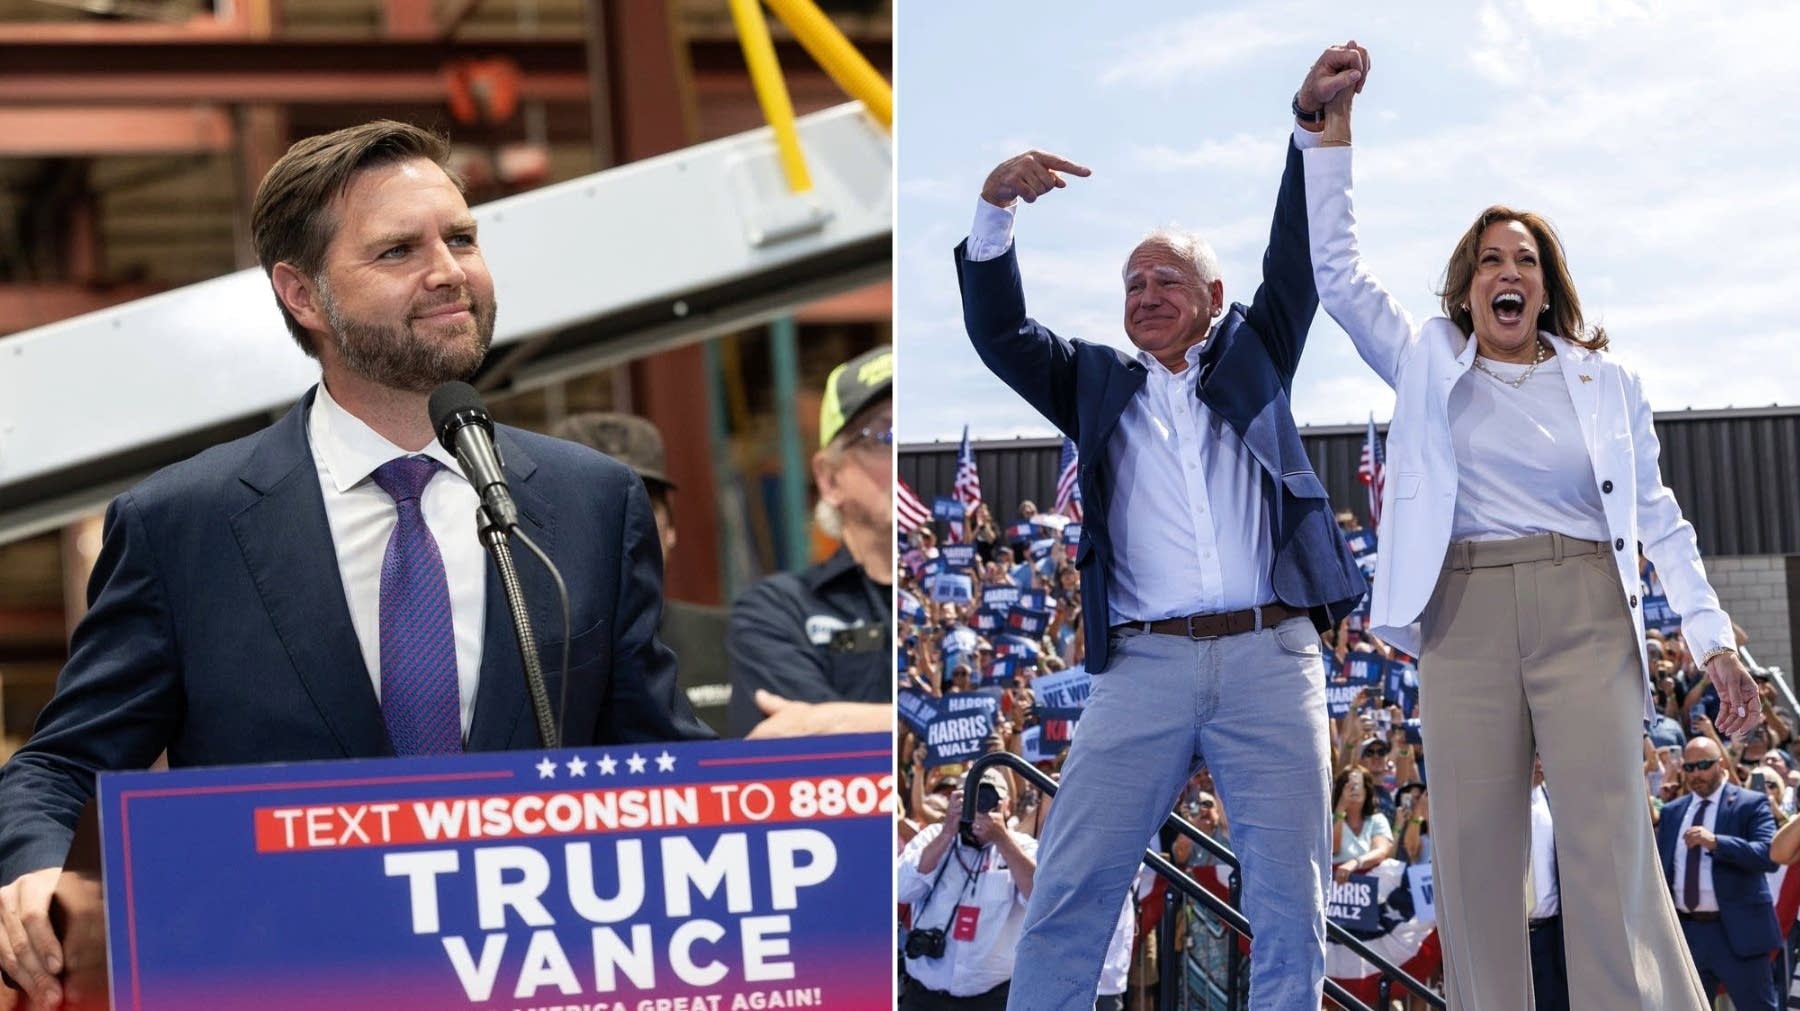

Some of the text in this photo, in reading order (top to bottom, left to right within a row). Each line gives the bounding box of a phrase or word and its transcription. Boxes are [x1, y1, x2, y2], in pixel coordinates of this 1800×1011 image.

[1043, 688, 1067, 708] WE
[928, 715, 988, 746] HARRIS
[937, 739, 980, 757] WALZ
[273, 775, 892, 848] TEXT WISCONSIN TO 8802
[384, 828, 838, 935] TRUMP
[441, 914, 796, 1002] VANCE
[637, 994, 722, 1011] GREAT
[731, 987, 822, 1011] AGAIN!
